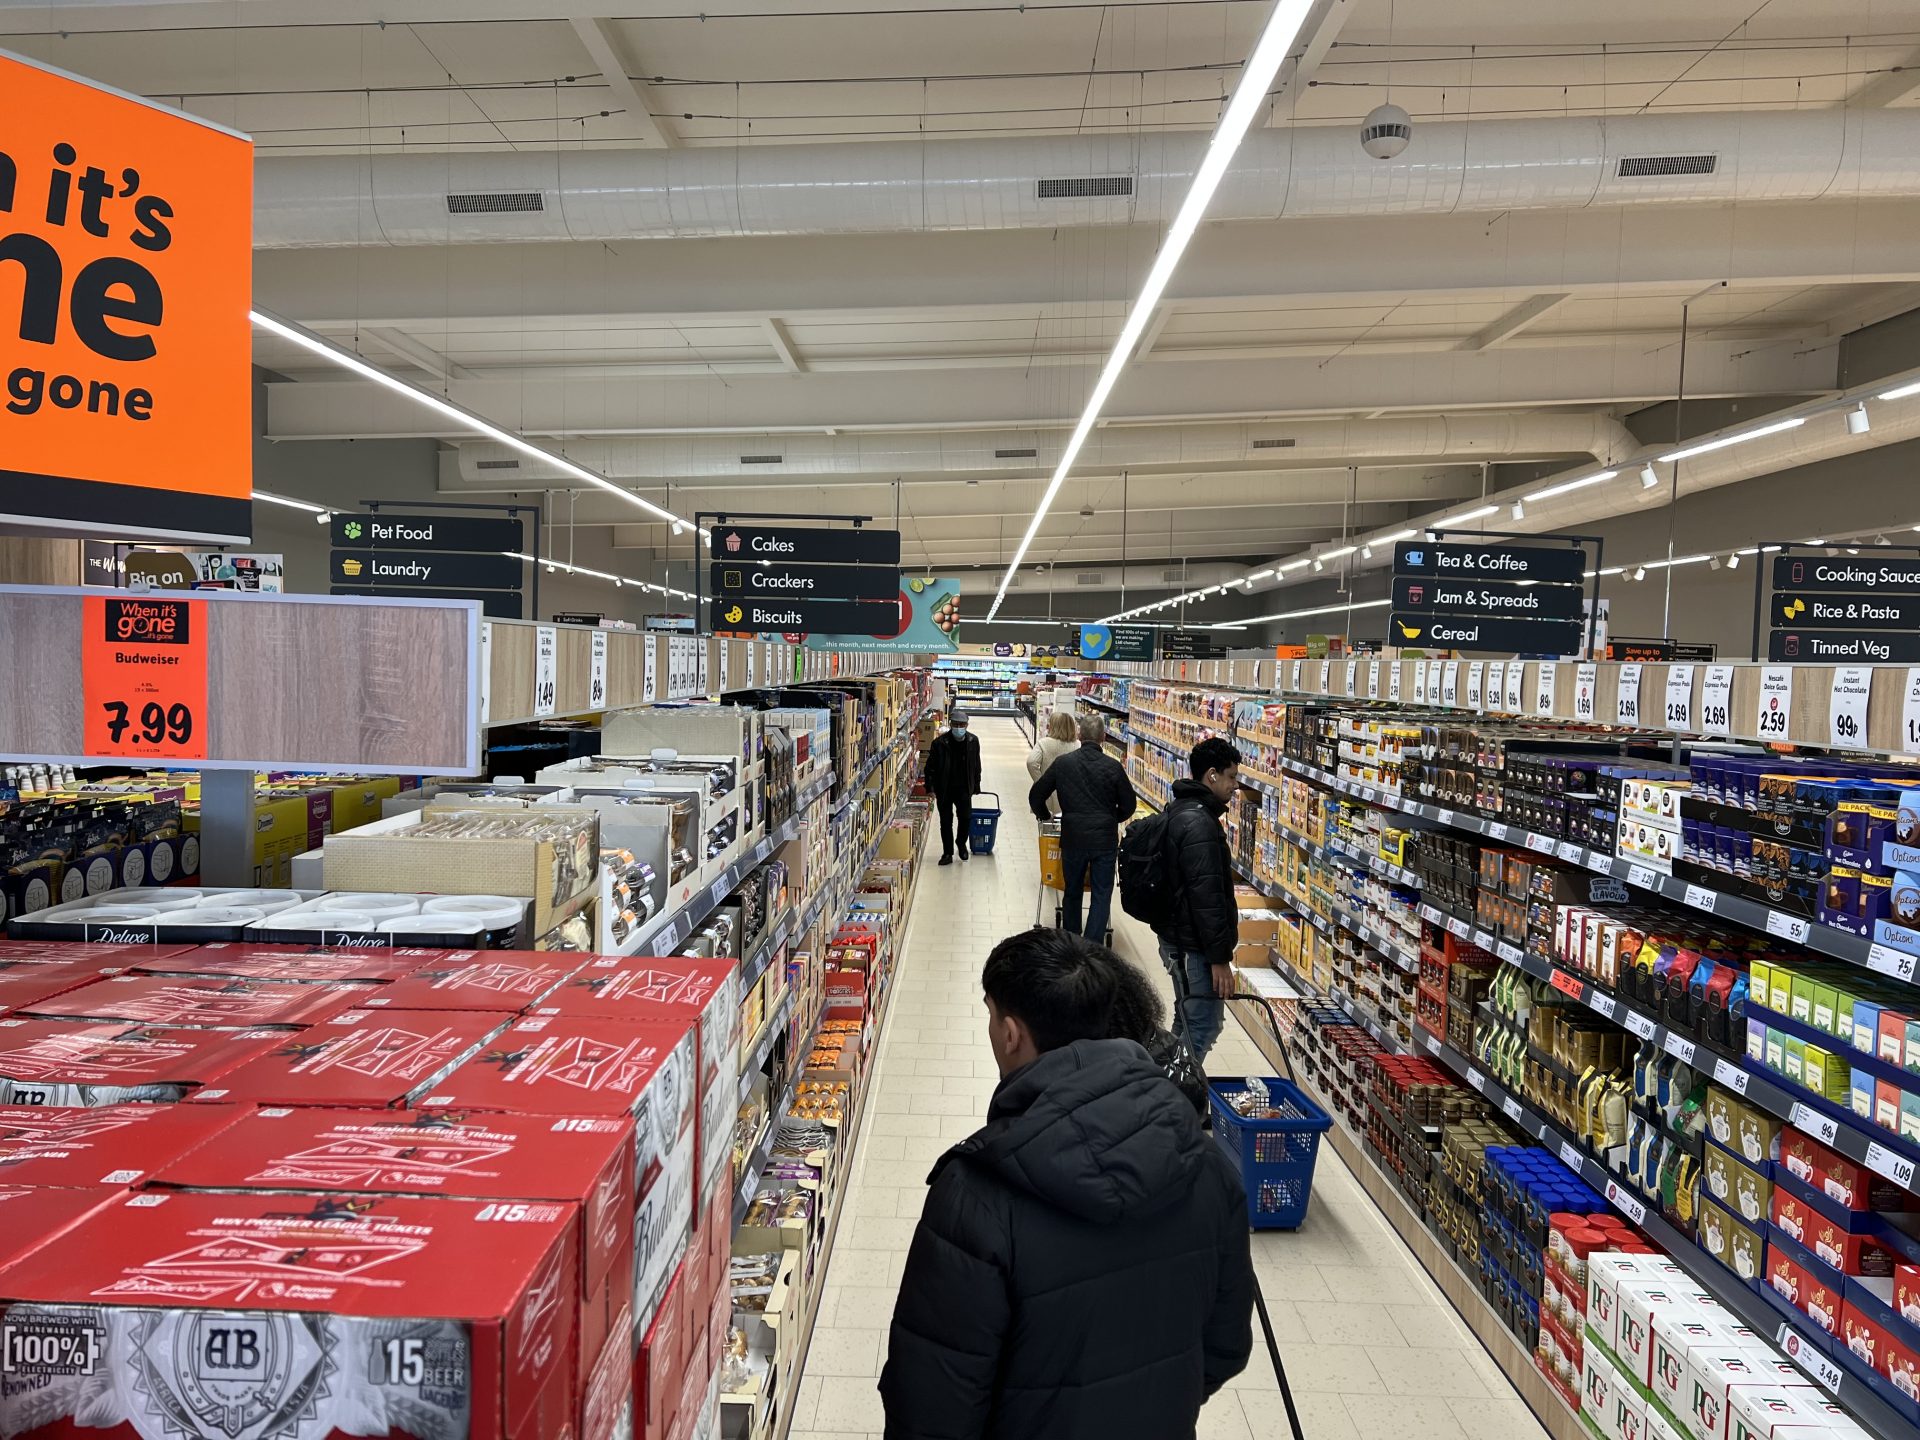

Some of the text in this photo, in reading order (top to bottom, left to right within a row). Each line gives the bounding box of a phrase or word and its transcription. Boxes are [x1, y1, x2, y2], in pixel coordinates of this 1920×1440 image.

[46, 142, 174, 252] it's
[6, 367, 153, 420] gone
[371, 524, 433, 540] Pet Food
[751, 536, 795, 552] Cakes
[89, 557, 102, 567] THE
[371, 560, 431, 580] Laundry
[1436, 551, 1528, 571] Tea & Coffee
[162, 572, 184, 583] on
[751, 573, 814, 589] Crackers
[1815, 566, 1876, 586] Cooking
[1434, 589, 1539, 609] Jam & Spreads
[121, 602, 177, 618] When it's
[752, 608, 802, 624] Biscuits
[1813, 603, 1900, 620] Rice & Pasta
[117, 616, 176, 638] gone
[1431, 624, 1479, 641] Cereal
[876, 642, 896, 650] month
[897, 642, 909, 650] and
[910, 643, 928, 651] every
[1811, 640, 1890, 660] Tinned Veg
[115, 652, 180, 665] Budweiser
[1843, 676, 1860, 684] Instant
[538, 681, 554, 708] 1.49
[1833, 686, 1867, 695] Hot Chocolate
[1540, 694, 1551, 709] 89p
[1577, 698, 1591, 714] 1.69
[1619, 700, 1636, 717] 2.69
[1667, 703, 1686, 722] 2.69
[1704, 705, 1725, 725] 2.69
[1760, 710, 1785, 732] 2.59
[103, 701, 192, 745] 7.99
[1837, 714, 1858, 738] 99p
[1641, 873, 1654, 885] 2.29
[1701, 895, 1713, 909] 2.59
[99, 927, 150, 944] Deluxe
[1789, 923, 1802, 938] 55p
[1884, 926, 1914, 945] Options
[336, 933, 386, 947] Deluxe
[1898, 958, 1913, 976] 75p
[1640, 1021, 1651, 1035] 1.09
[1681, 1044, 1693, 1060] 1.49
[1735, 1073, 1746, 1088] 95p
[333, 1124, 518, 1141] WIN PREMIER LEAGUE TICKETS
[566, 1119, 596, 1132] 15
[1821, 1122, 1834, 1140] 99p
[1893, 1161, 1911, 1182] 1.09
[489, 1204, 530, 1223] 15
[1629, 1203, 1642, 1219] 2.59
[212, 1217, 433, 1235] WIN PREMIER LEAGUE TICKETS
[1592, 1280, 1609, 1322] PG
[4, 1314, 96, 1326] NOW BREWED WITH
[23, 1325, 76, 1335] RENEWABLE
[1622, 1309, 1641, 1355] PG
[12, 1335, 85, 1366] 100%
[204, 1328, 261, 1370] AB
[22, 1366, 76, 1375] ELECTRICITY
[386, 1338, 424, 1386] 15
[1657, 1343, 1678, 1391] PG
[423, 1368, 465, 1387] BEER
[1819, 1363, 1839, 1387] 3.48
[152, 1375, 182, 1415] AFRICA
[1586, 1364, 1605, 1408] PG
[282, 1383, 310, 1416] ASIA
[1692, 1378, 1716, 1431] PG
